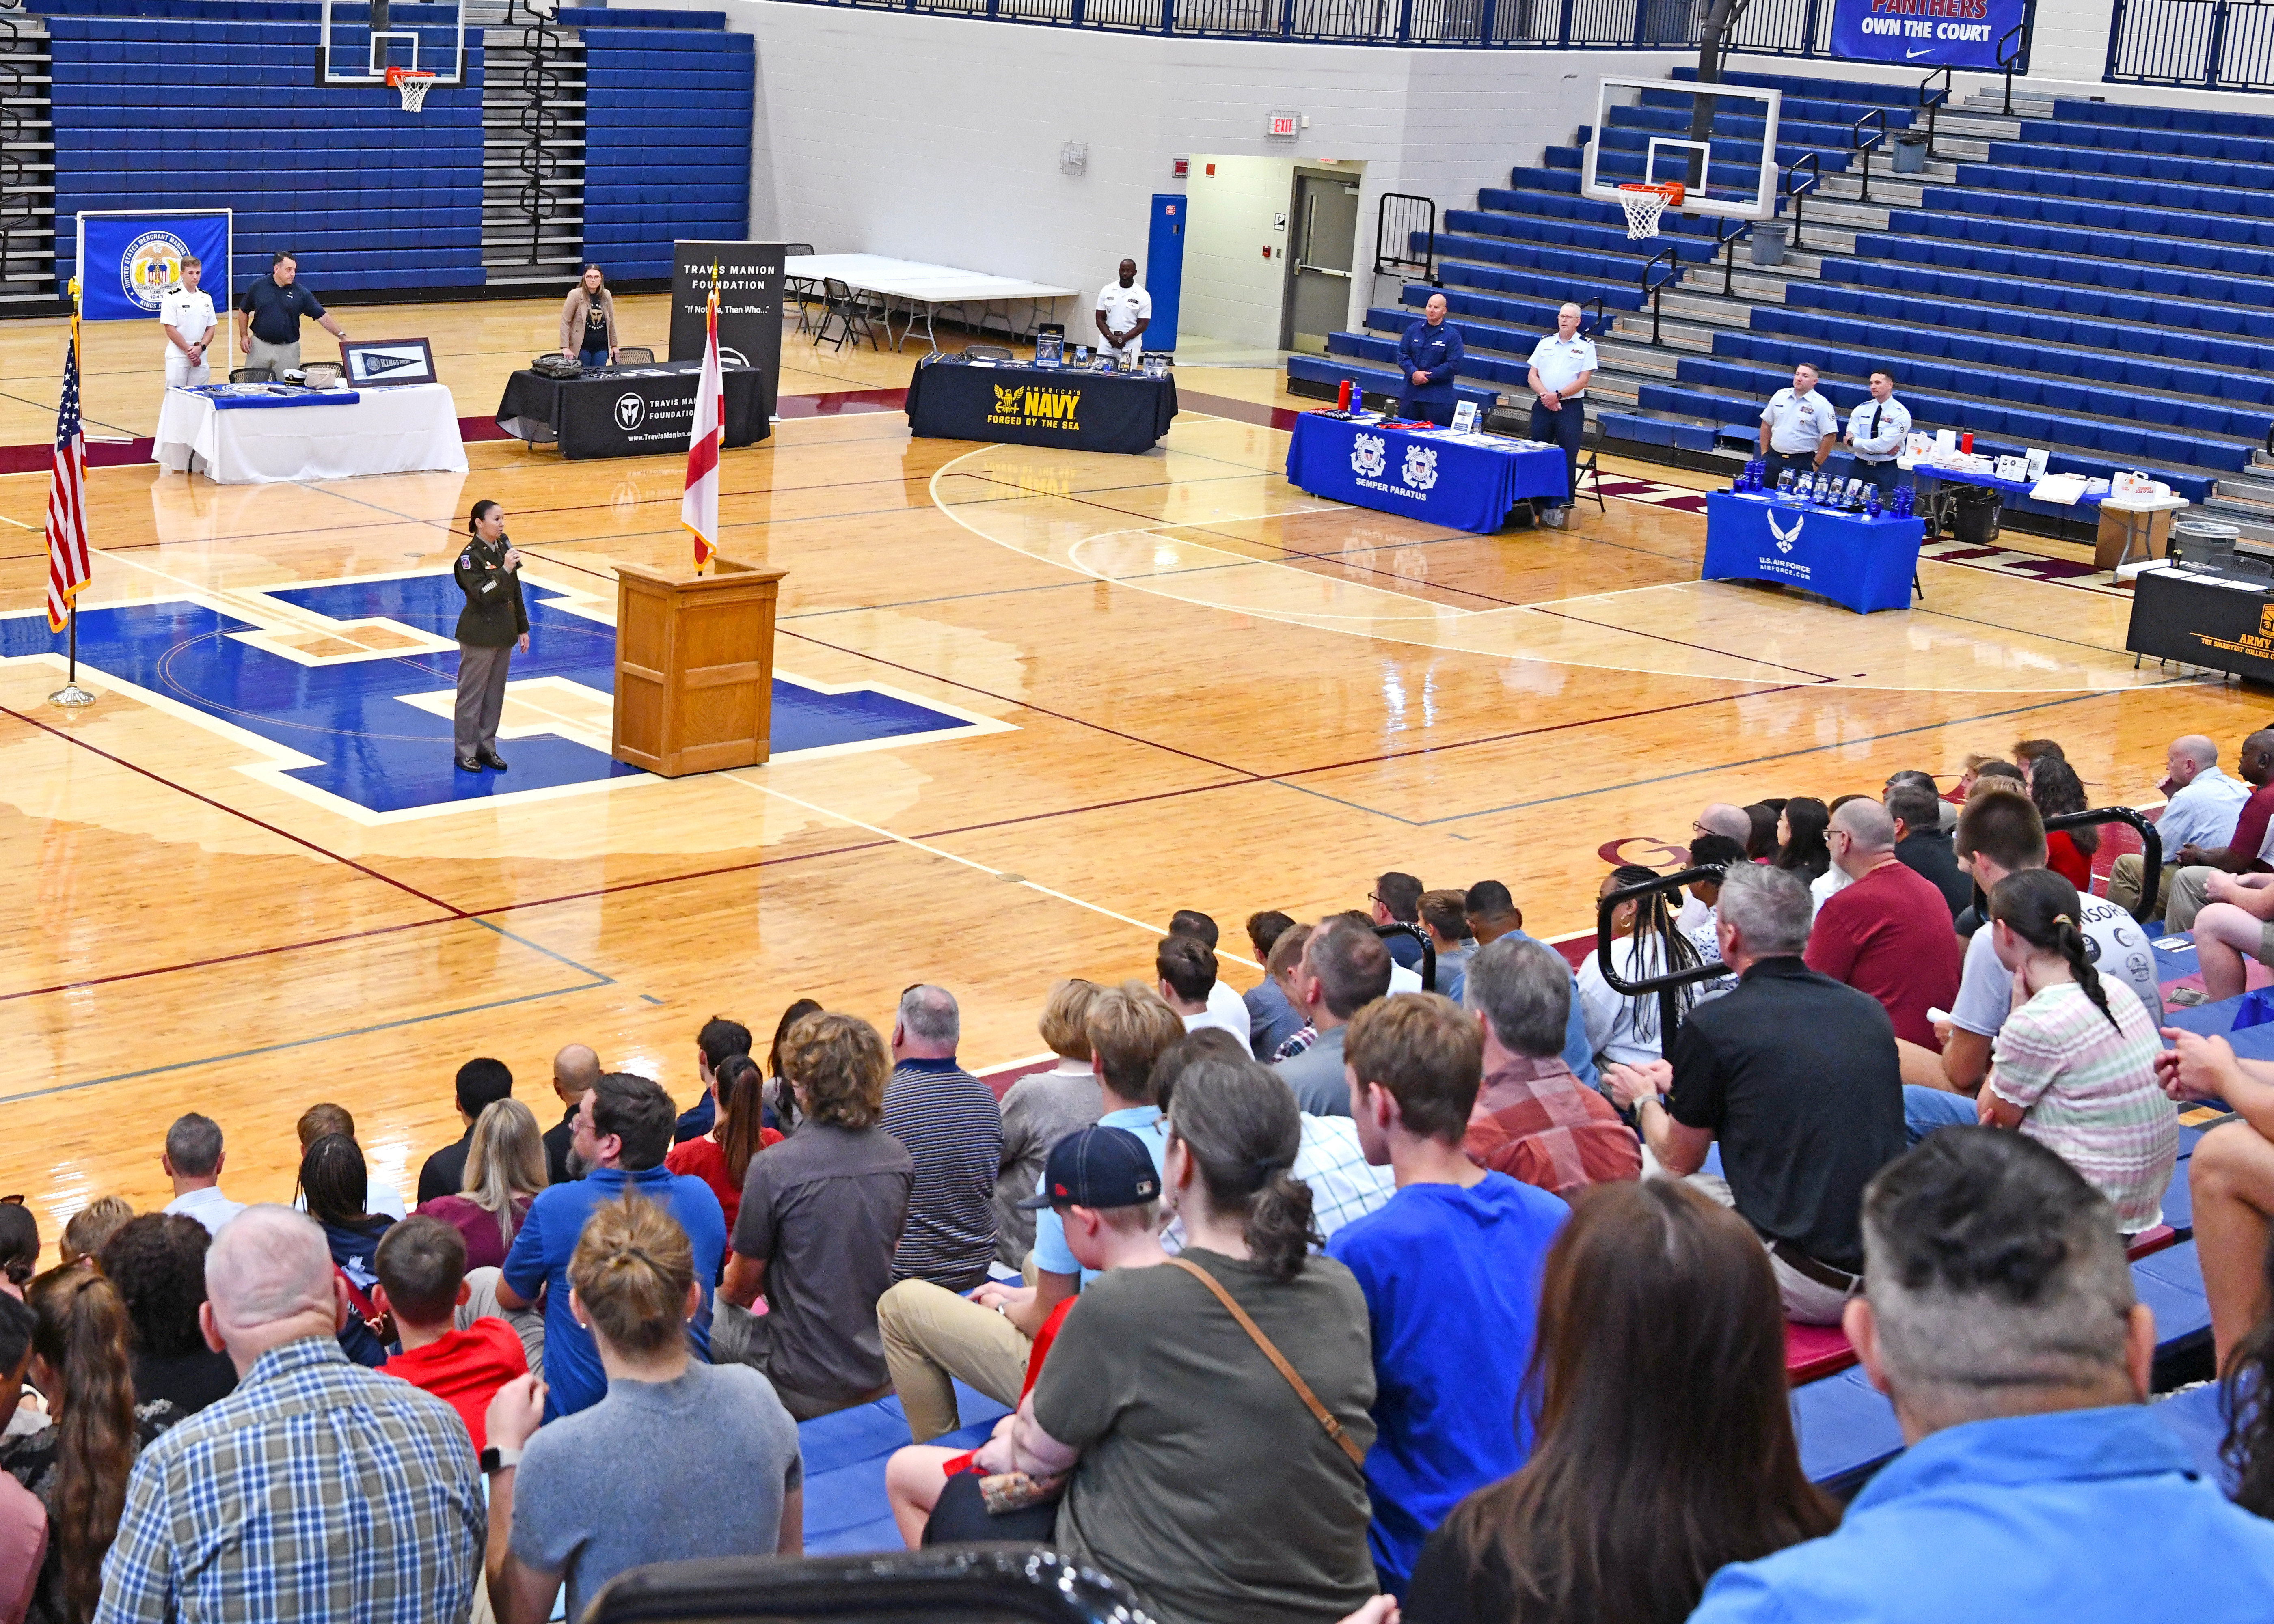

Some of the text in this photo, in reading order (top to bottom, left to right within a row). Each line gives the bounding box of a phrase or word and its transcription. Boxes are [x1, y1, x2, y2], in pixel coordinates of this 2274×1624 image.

[1871, 0, 1987, 19] PANTHERS
[1862, 17, 1991, 41] OWN THE COURT
[1275, 119, 1293, 132] EXIT
[125, 243, 138, 264] STATES
[138, 234, 168, 245] MERCHANT
[169, 237, 187, 256] MARINE
[684, 265, 775, 274] TRAVS MANION
[692, 280, 765, 289] FOUNDATION
[140, 300, 156, 309] KINGS
[380, 359, 399, 368] KINGS
[1026, 386, 1081, 395] AMERICA'S
[650, 399, 678, 408] TRAVIS
[1024, 392, 1080, 420] NAVY
[650, 410, 694, 420] FOUNDATIO
[987, 415, 1080, 430] FORGED BY THE SEA
[628, 431, 691, 441] www.TravisManion.o
[1356, 477, 1427, 501] SEMPER PARATUS
[1760, 565, 1810, 580] AIRFORCE.COM
[1786, 561, 1811, 574] FORCE
[2201, 638, 2212, 646] THE
[2214, 641, 2244, 653] SMARTEST
[2245, 648, 2269, 658] COLLEGE
[2239, 633, 2272, 649] ARMY
[2080, 904, 2128, 925] NSORS
